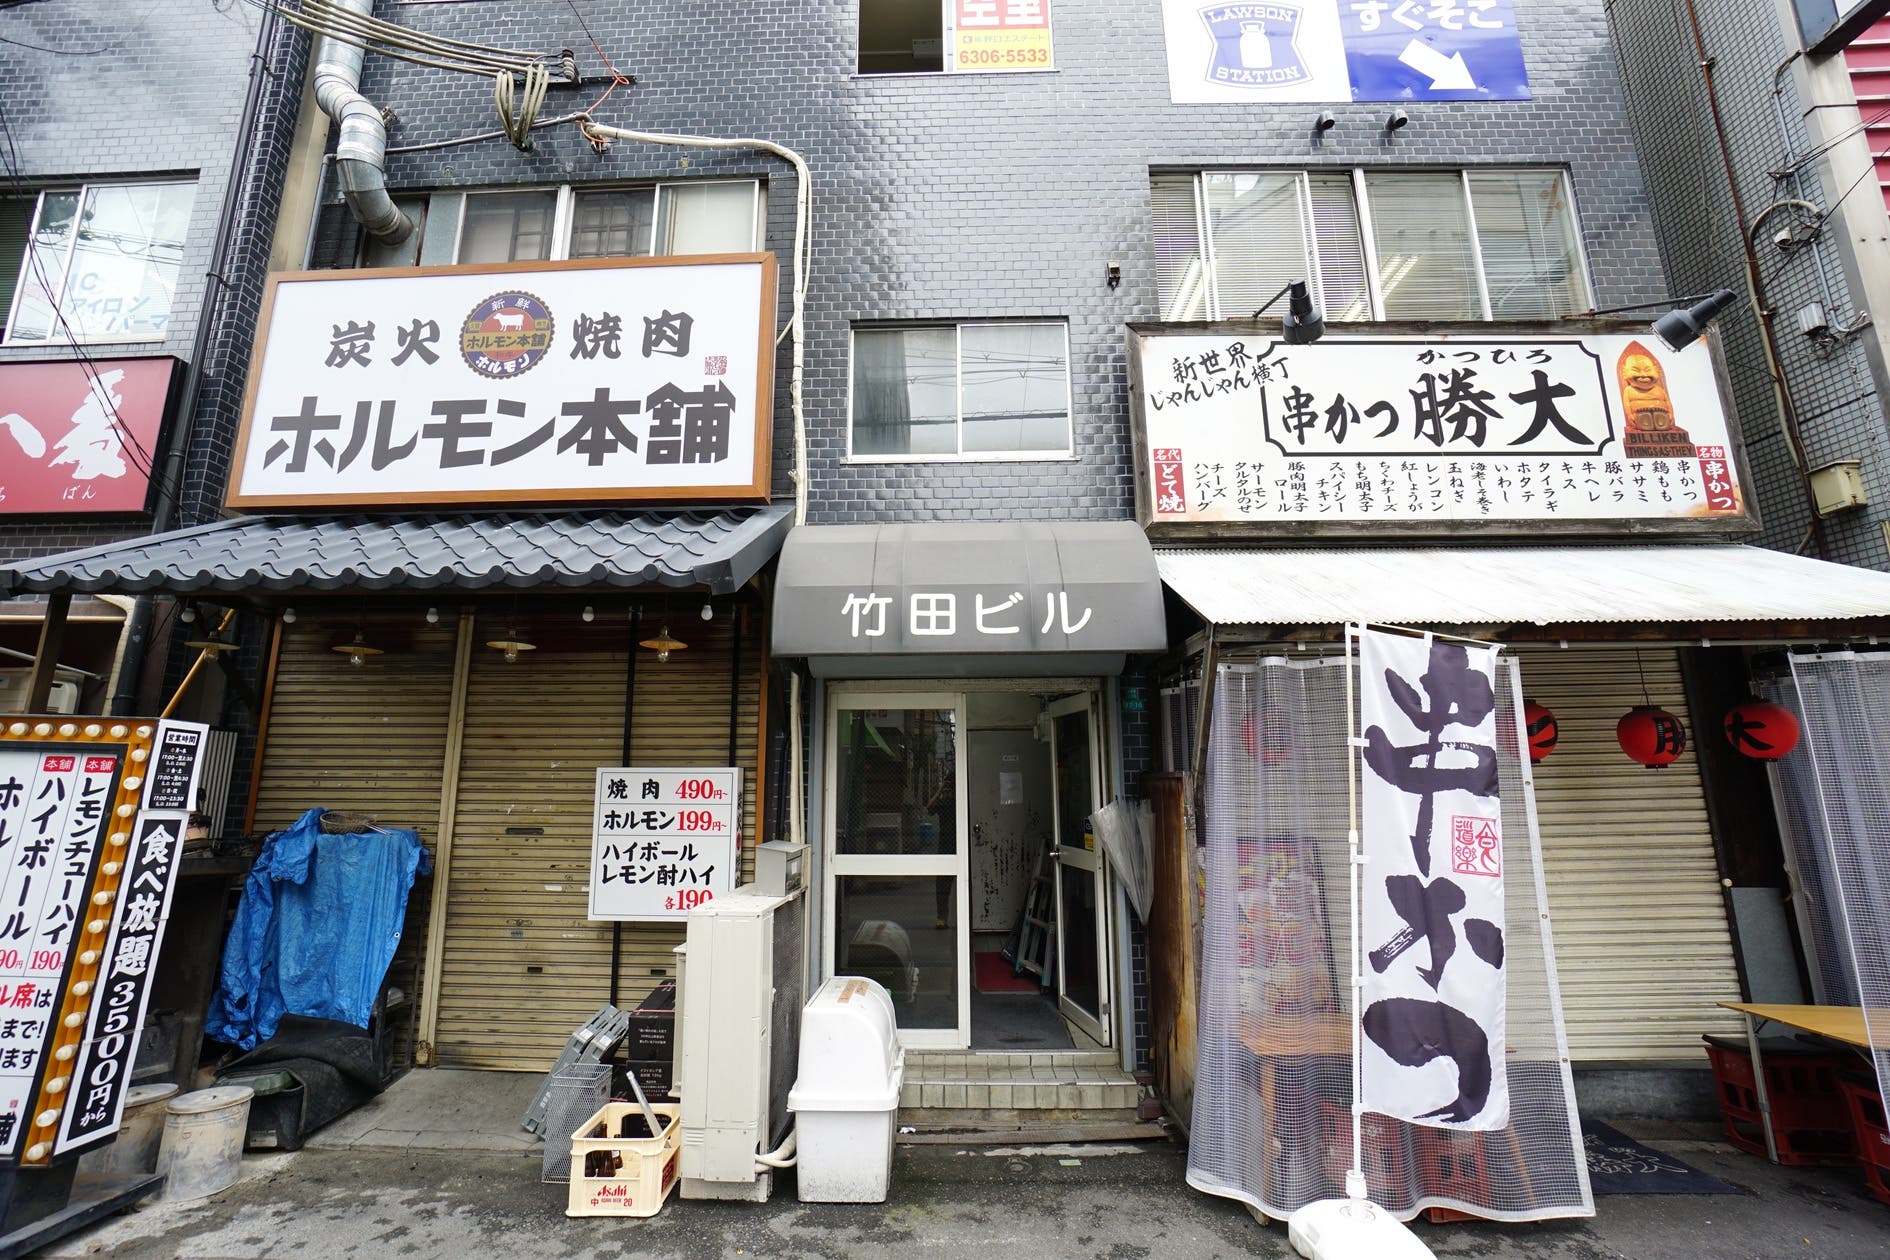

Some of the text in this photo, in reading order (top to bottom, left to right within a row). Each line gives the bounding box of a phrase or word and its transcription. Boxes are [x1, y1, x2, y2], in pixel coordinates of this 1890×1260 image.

[1207, 5, 1294, 23] LAWSON
[1351, 0, 1503, 31] すぐそこ
[1215, 65, 1302, 83] STATION
[106, 313, 169, 332] パーマ
[491, 297, 531, 311] 新鮮
[325, 310, 695, 369] 炭火 焼肉
[466, 332, 547, 350] ホルモン本舗
[1416, 348, 1552, 365] かつひろ
[475, 352, 530, 374] ホルモン
[1172, 341, 1253, 384] 新世界
[1150, 356, 1288, 411] じゃんじゃん横丁
[263, 379, 736, 475] ホルモン本舗
[1281, 368, 1595, 448] 串かつ勝大
[1155, 449, 1181, 461] 名代
[1629, 433, 1688, 444] BILLIKEN
[1699, 446, 1723, 458] 名物
[63, 484, 96, 500] ばん
[1157, 463, 1185, 512] どて焼
[1194, 463, 1212, 512] ハンバーグ
[1211, 463, 1228, 498] チーズ
[1235, 462, 1253, 513] タルタルのせ
[1251, 463, 1268, 510] サーモン
[1274, 479, 1292, 512] ロール
[1288, 461, 1309, 512] 豚肉明太子
[1316, 478, 1331, 512] チキン
[1355, 461, 1375, 512] もち明太子
[1380, 461, 1398, 512] ちくわチーズ
[1400, 461, 1423, 512] 紅しょうが
[1426, 463, 1445, 512] レンコン
[1448, 462, 1464, 503] 玉ねぎ
[1495, 463, 1512, 503] いわし
[1517, 462, 1535, 503] ホタテ
[1539, 462, 1558, 512] タイラギ
[1561, 461, 1577, 490] キス
[1582, 461, 1600, 502] 牛ヘレ
[1604, 460, 1624, 502] 豚バラ
[1630, 461, 1648, 502] ササミ
[1652, 460, 1672, 502] 鶏もも
[1677, 459, 1697, 501] 串かつ
[1705, 460, 1732, 508] 串かつ
[841, 591, 1092, 638] 竹田ビル
[168, 733, 197, 745] 営業時間
[1726, 712, 1776, 750] 大
[45, 758, 74, 771] 本舗
[86, 758, 114, 771] 本舗
[607, 778, 660, 800] 焼肉
[602, 809, 675, 831] ホルモン
[0, 777, 65, 941] ハイボール
[42, 777, 106, 945] レモンチューハイ
[602, 840, 699, 862] ハイボール
[601, 863, 715, 886] レモン酎ハイ
[1362, 643, 1504, 1126] 串かつ
[79, 823, 175, 1128] 食べ放題3500円から
[0, 1047, 38, 1070] ます
[590, 1197, 599, 1207] 中
[597, 1184, 628, 1197] Asahi
[624, 1198, 633, 1207] 20
